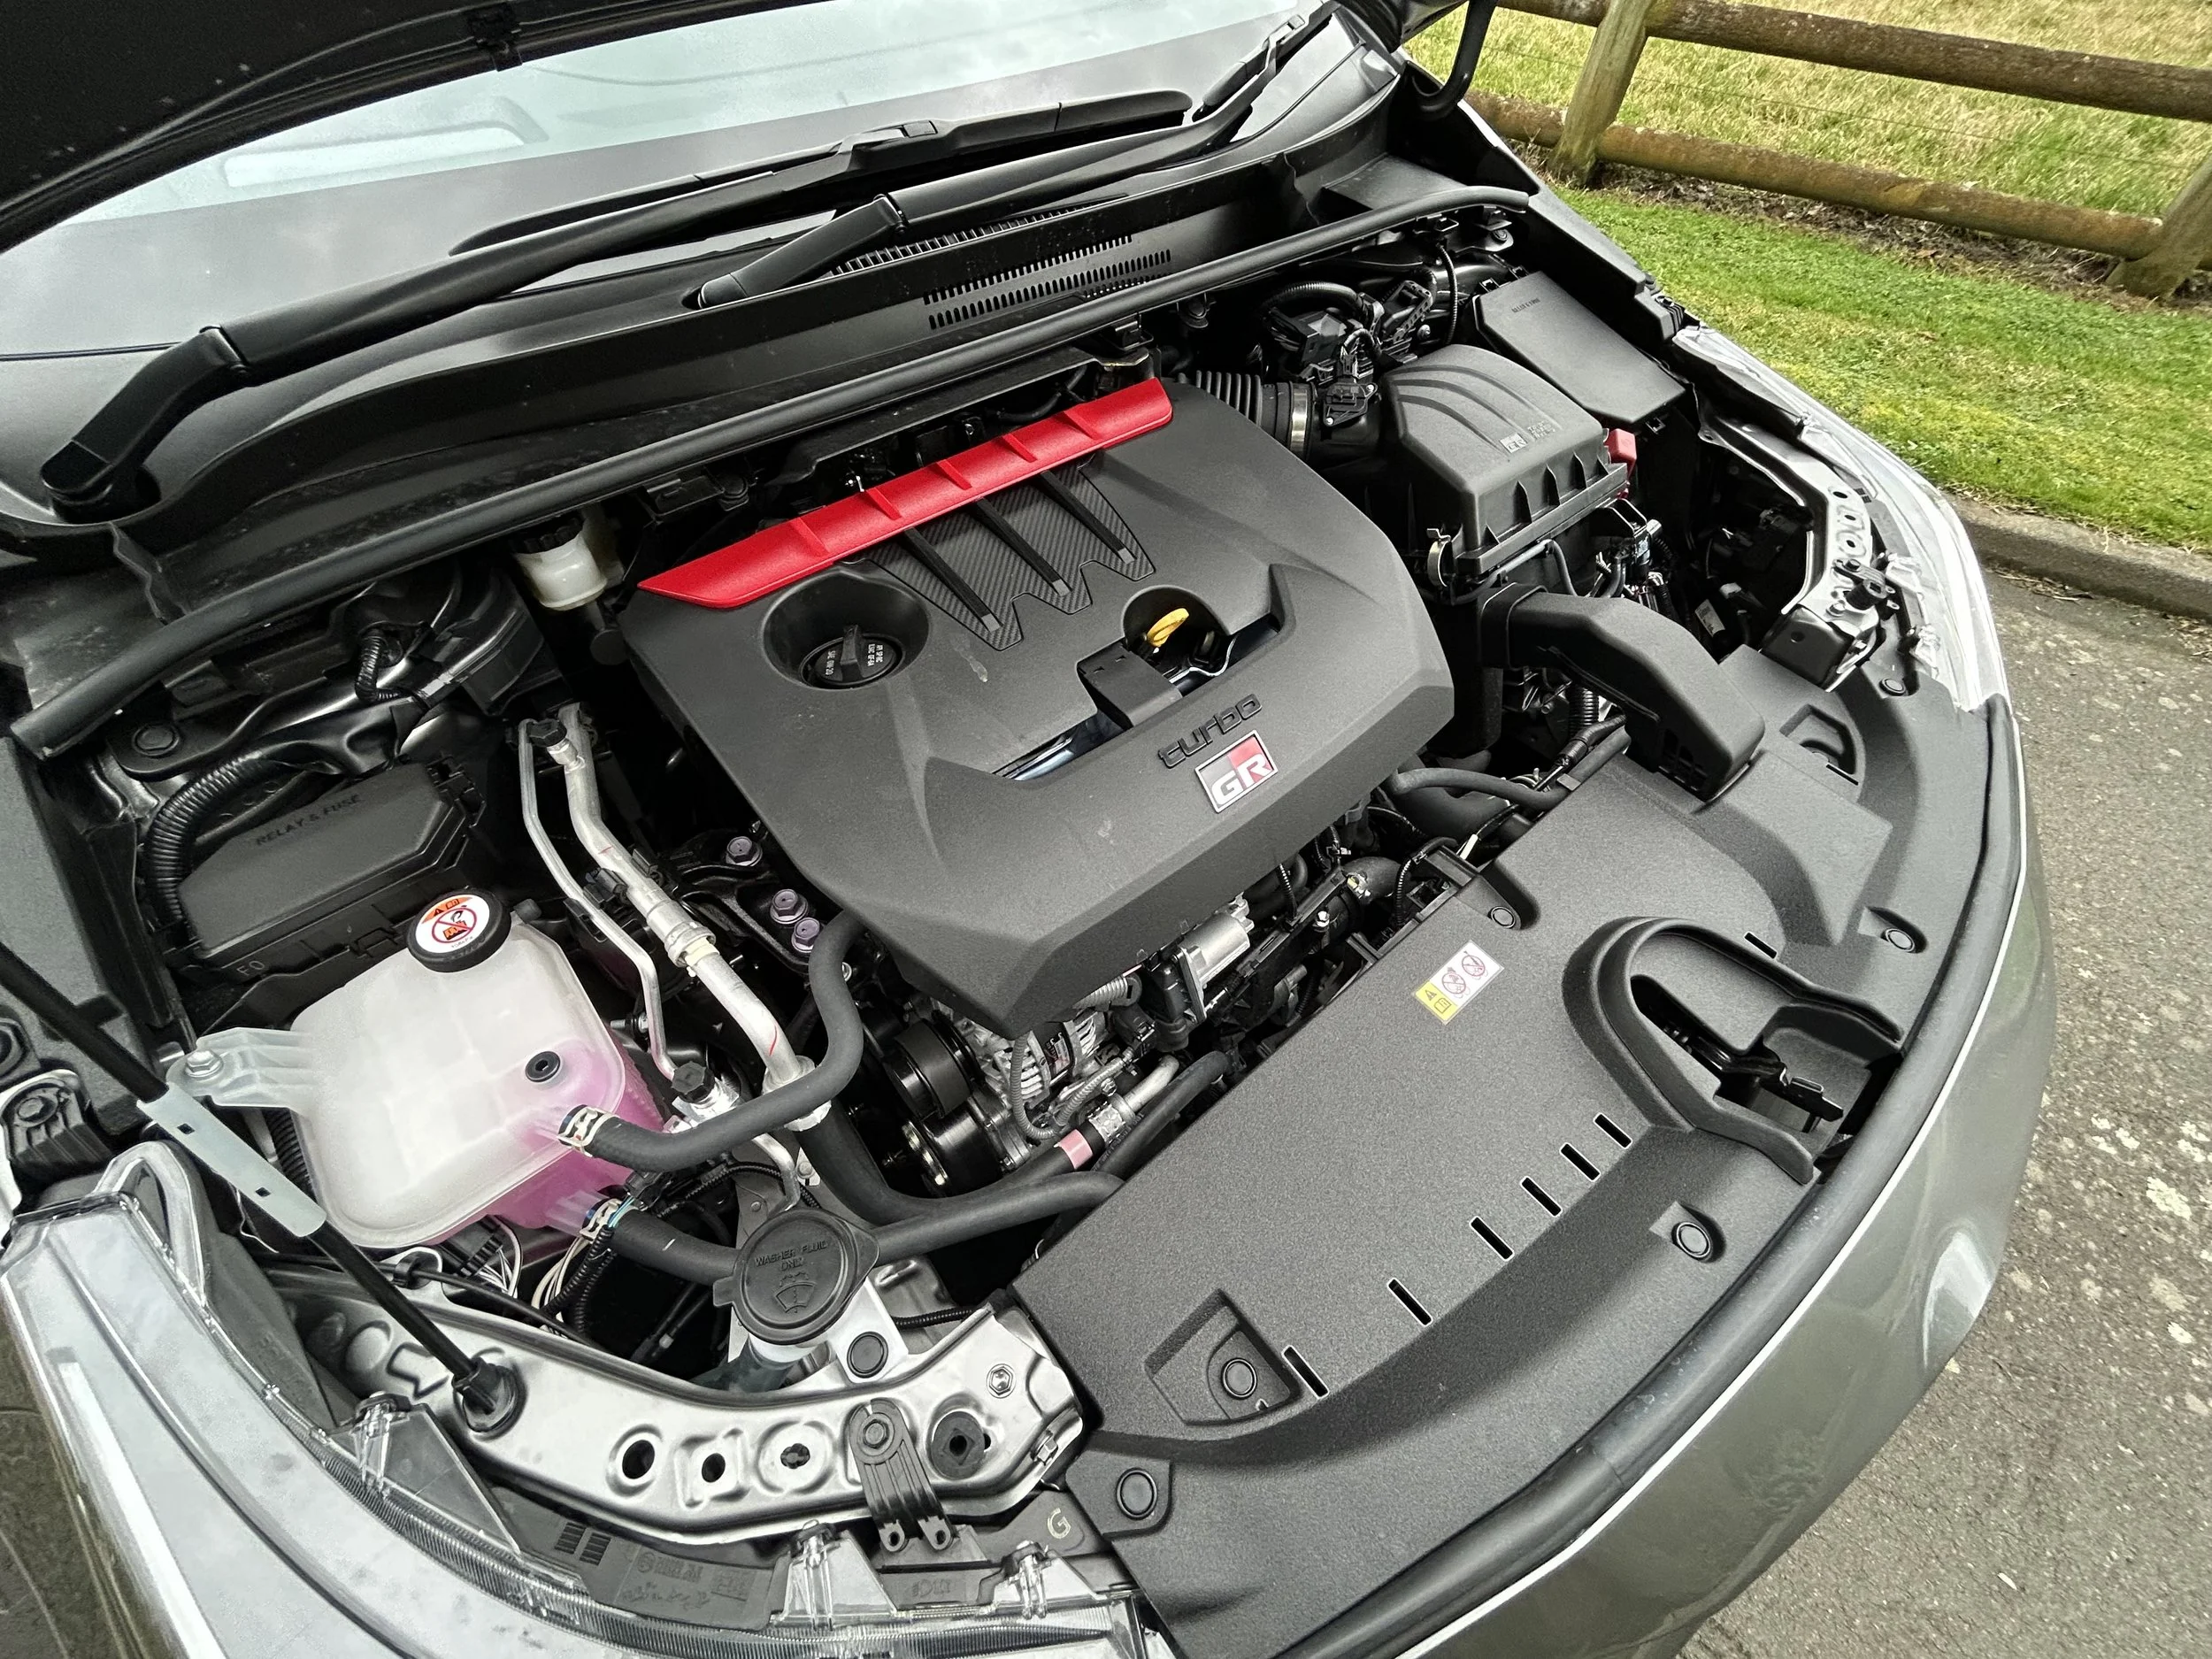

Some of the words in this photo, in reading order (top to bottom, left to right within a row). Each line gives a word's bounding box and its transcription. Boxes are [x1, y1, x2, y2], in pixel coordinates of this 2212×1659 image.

[1158, 694, 1263, 769] turbo
[1211, 753, 1272, 805] GR
[256, 818, 305, 846] RELAY
[323, 794, 360, 815] FUSE
[755, 1248, 797, 1267] WASHER
